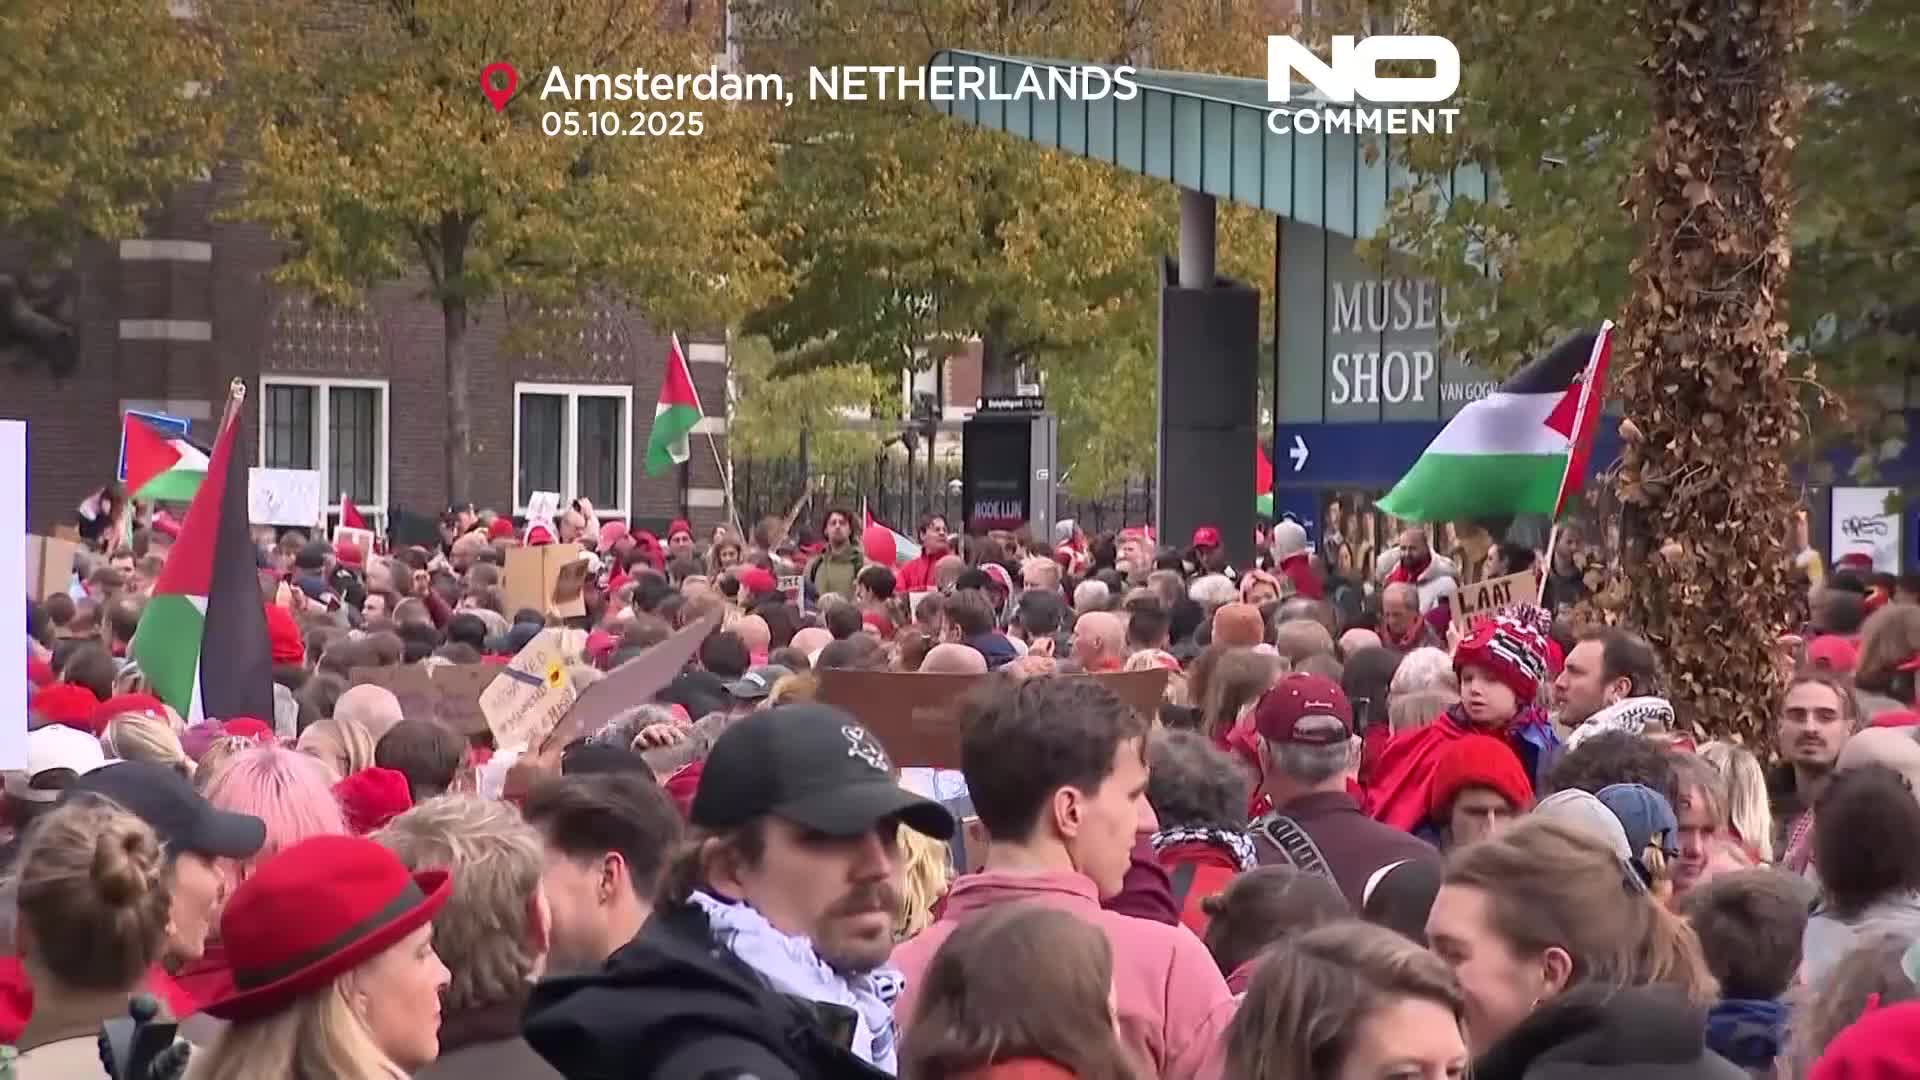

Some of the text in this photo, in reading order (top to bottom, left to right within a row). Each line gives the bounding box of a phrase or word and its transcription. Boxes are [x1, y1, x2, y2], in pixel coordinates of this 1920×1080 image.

[1332, 279, 1462, 334] MUSEU
[1331, 351, 1434, 404] SHOP
[1440, 383, 1463, 401] VAN
[1458, 579, 1512, 614] LAAT
